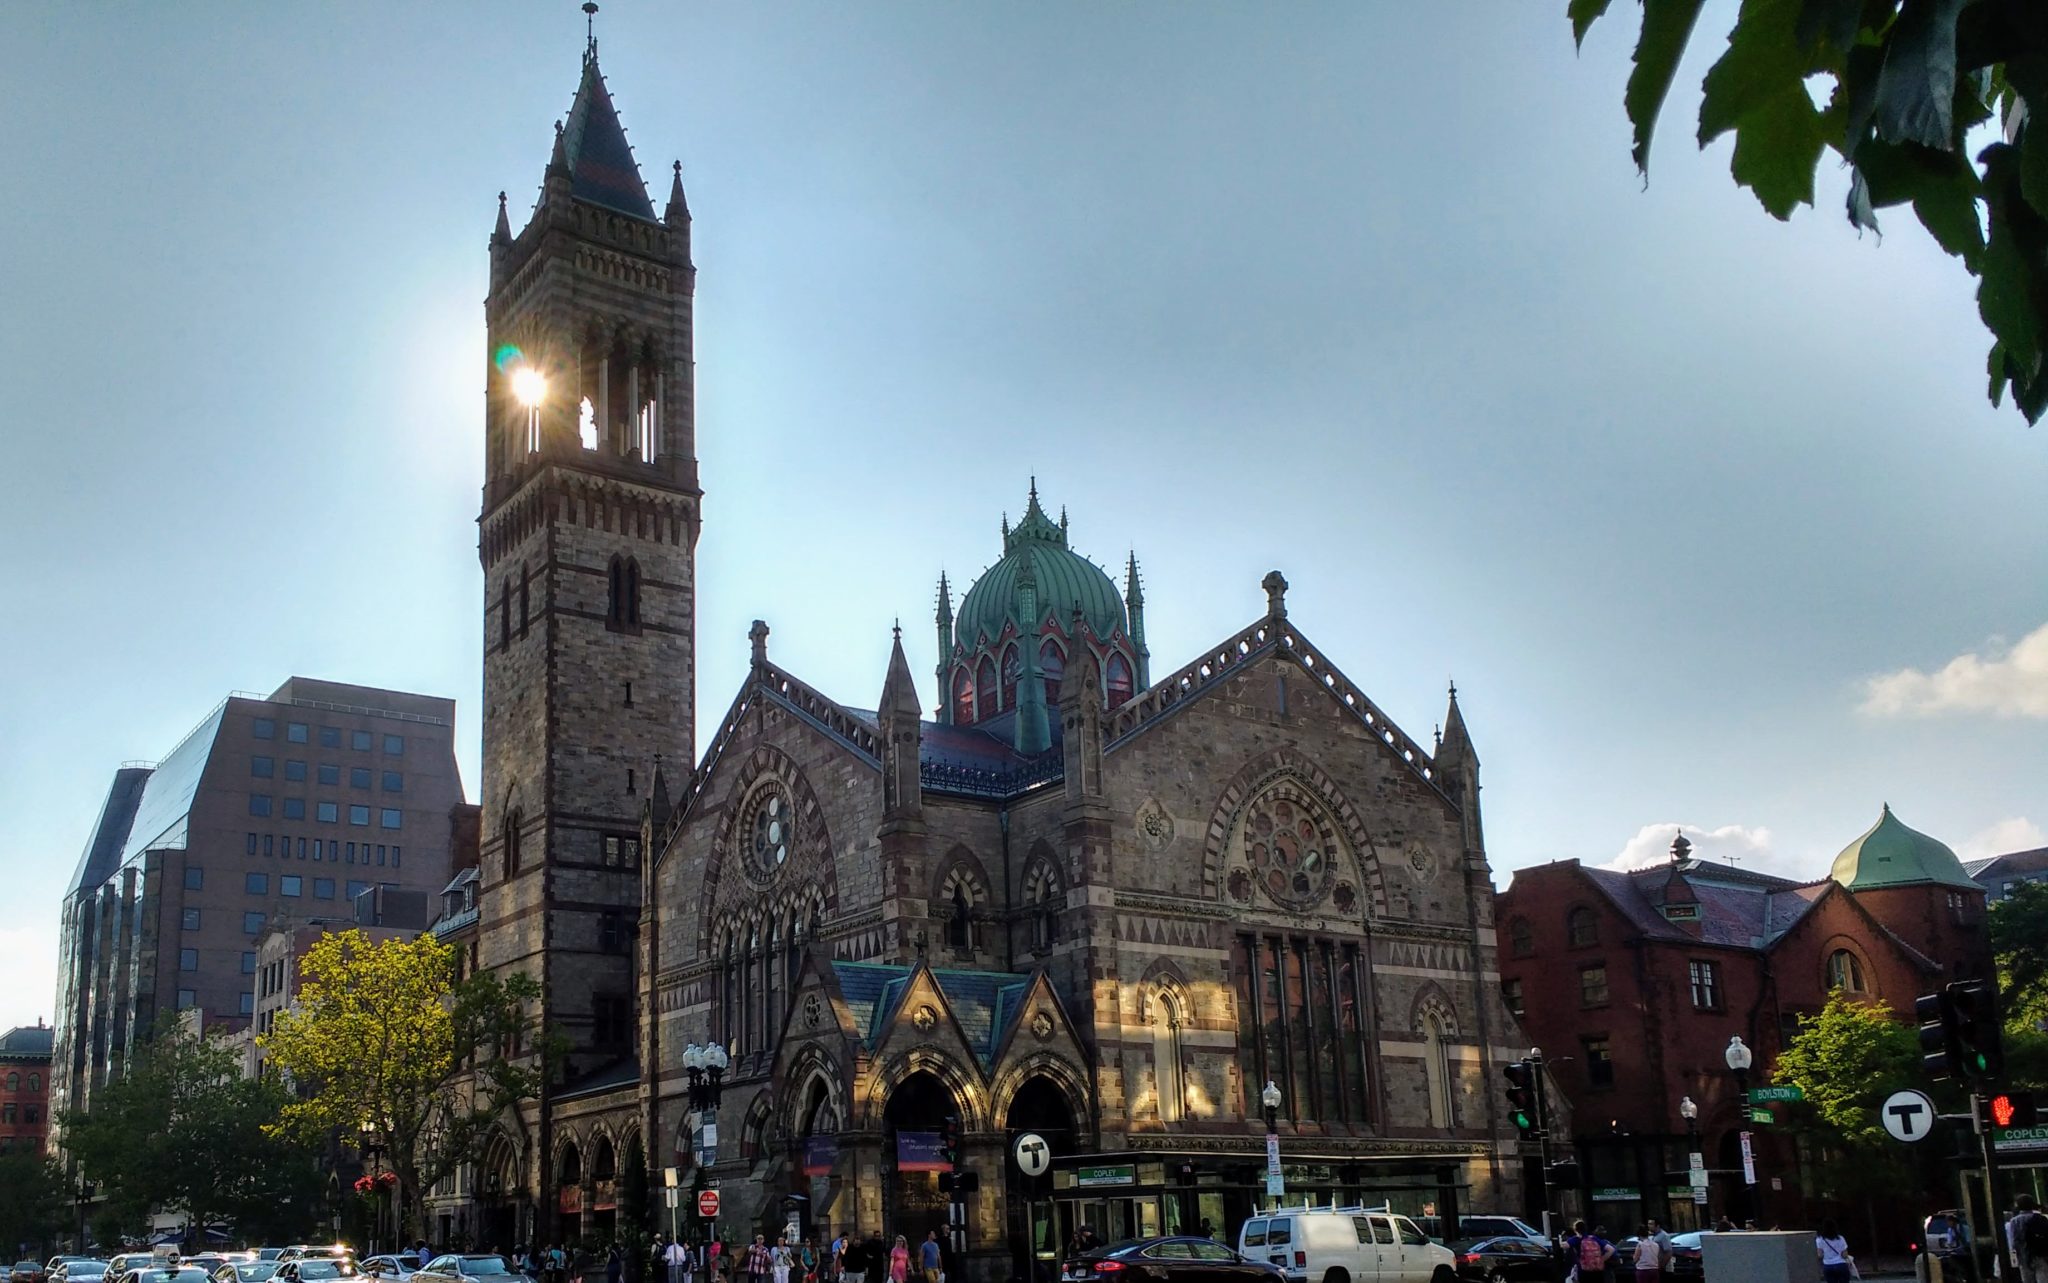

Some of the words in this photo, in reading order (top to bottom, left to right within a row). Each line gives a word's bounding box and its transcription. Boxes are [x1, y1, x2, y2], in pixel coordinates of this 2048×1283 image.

[1757, 1088, 1790, 1099] BOYLSTON
[1889, 1104, 1923, 1135] T
[2005, 1128, 2048, 1139] COPLEY
[1021, 1141, 1044, 1169] T
[1093, 1169, 1116, 1178] COPLEY
